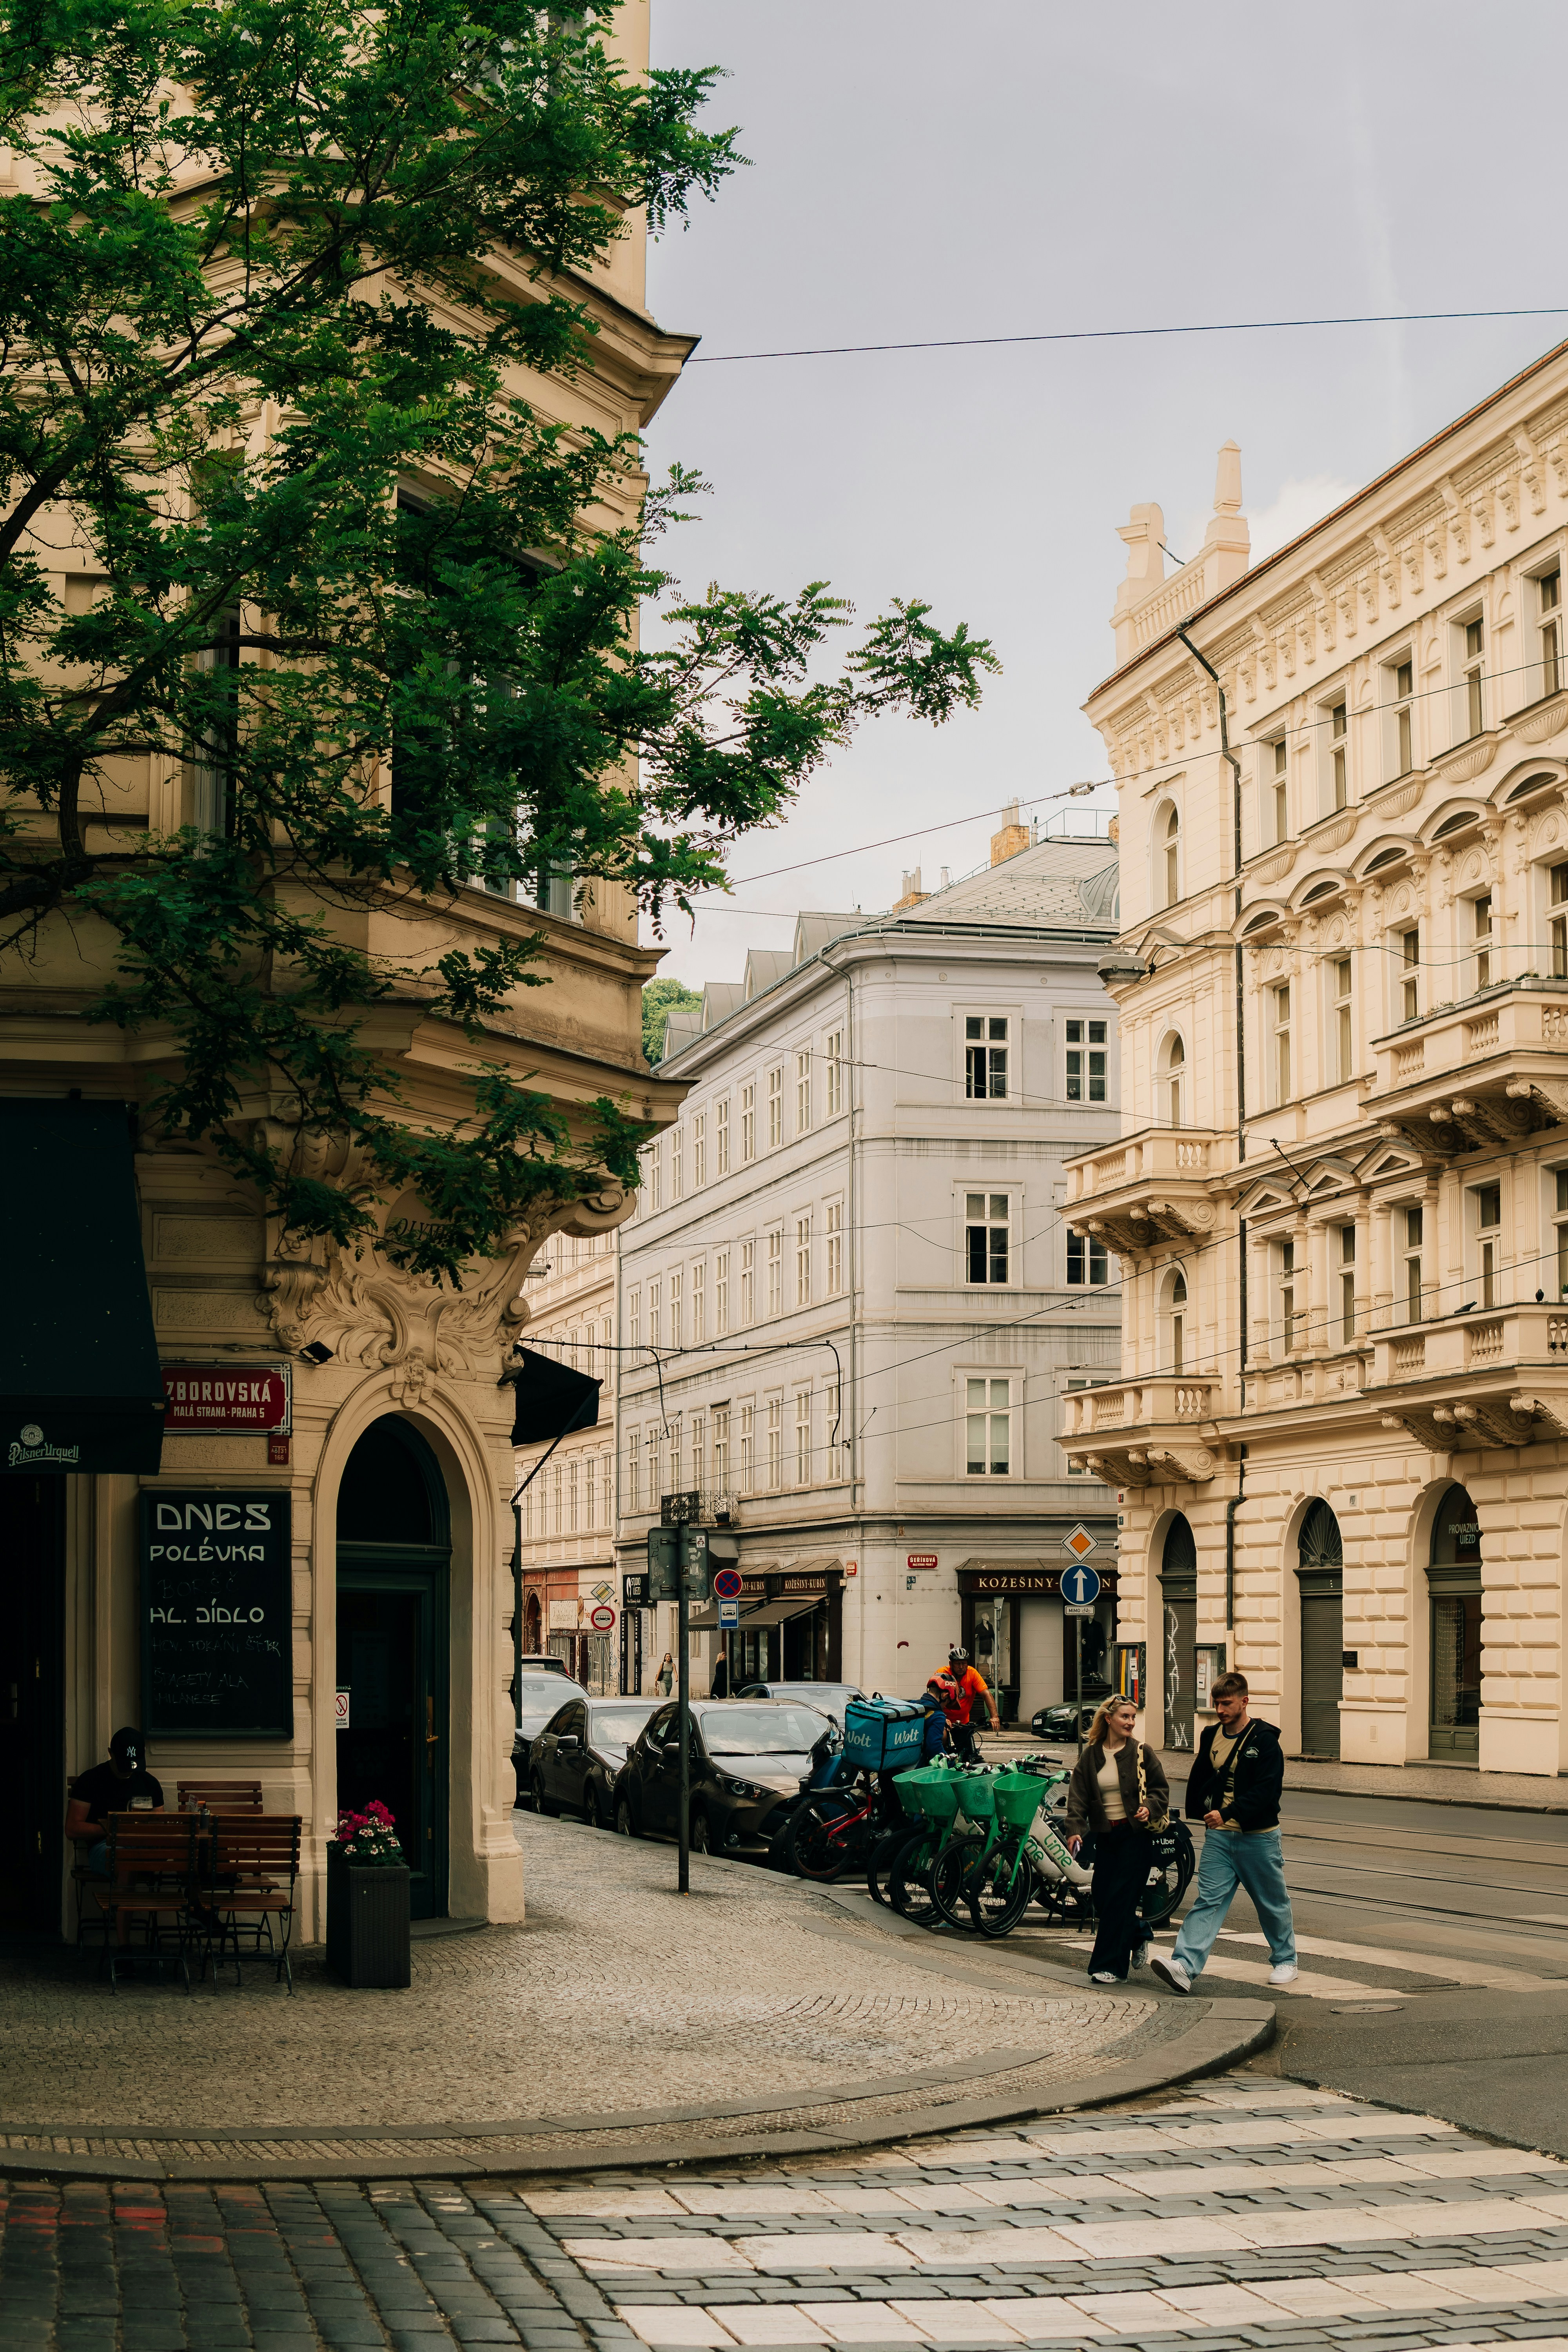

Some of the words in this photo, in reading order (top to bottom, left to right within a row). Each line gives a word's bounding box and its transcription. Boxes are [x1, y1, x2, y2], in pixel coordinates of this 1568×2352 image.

[166, 1379, 271, 1402] ZBOROVSKÁ
[174, 1404, 194, 1417] MALÁ
[197, 1406, 226, 1417] STRANA
[232, 1407, 257, 1418] PRAHA
[260, 1408, 265, 1418] 5
[8, 1442, 45, 1466] Pilsner
[44, 1442, 79, 1463] Urquell
[157, 1504, 270, 1530] DNES
[1449, 1523, 1479, 1534] PROVAZNIC
[150, 1537, 264, 1561] POLÉVKA
[742, 1580, 764, 1590] INY-KUBÍN
[150, 1607, 187, 1623] HL.
[196, 1598, 264, 1623] JÍDLO
[846, 1731, 871, 1747] Wolt
[894, 1728, 919, 1745] Wolt
[1027, 1839, 1044, 1862] me
[1044, 1832, 1072, 1867] Lime
